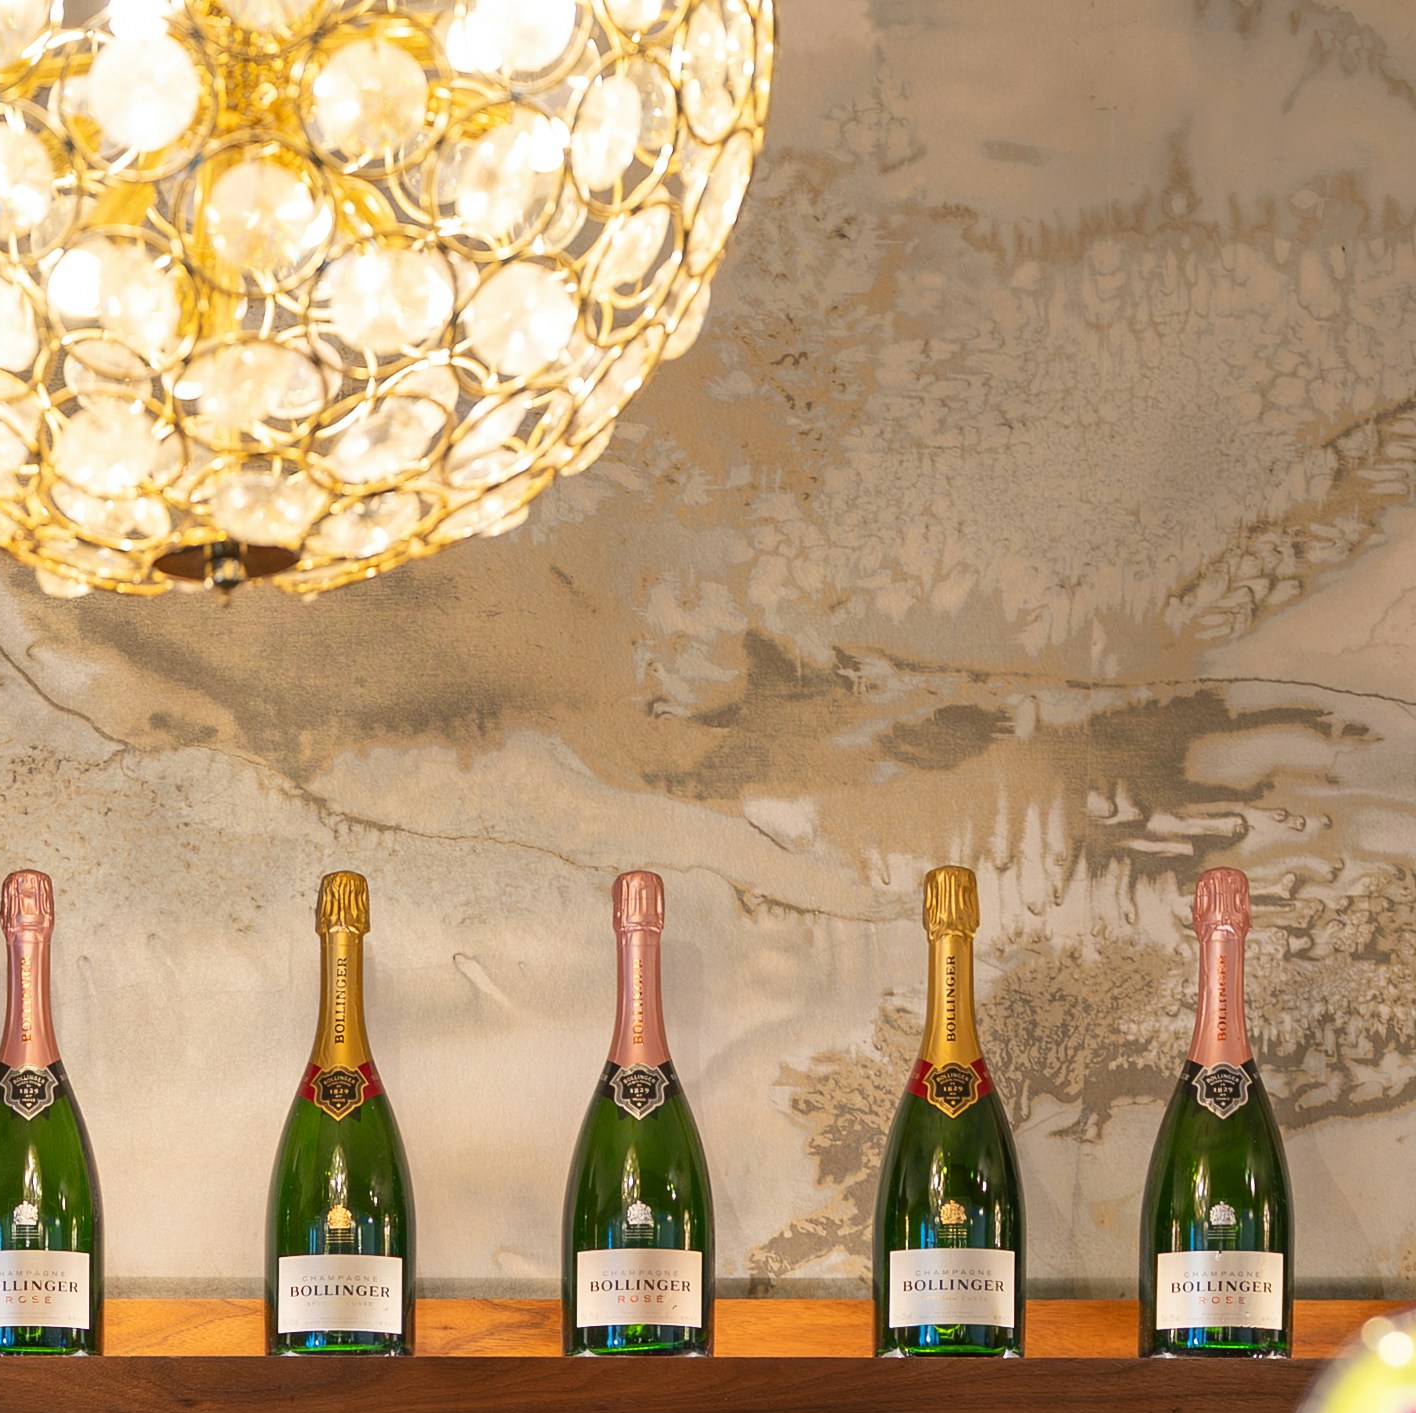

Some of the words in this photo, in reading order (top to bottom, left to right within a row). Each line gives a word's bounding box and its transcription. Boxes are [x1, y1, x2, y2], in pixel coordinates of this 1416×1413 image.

[334, 956, 347, 1044] BOLLINGER
[945, 955, 956, 1042] BOLLINGER
[1217, 954, 1227, 1042] BOLLINGER
[290, 1285, 391, 1298] BOLLINGER
[590, 1280, 691, 1293] BOLLINGER
[902, 1280, 1005, 1293] BOLLINGER
[1171, 1281, 1272, 1294] BOLLINGER
[617, 1292, 664, 1303] ROSÉ
